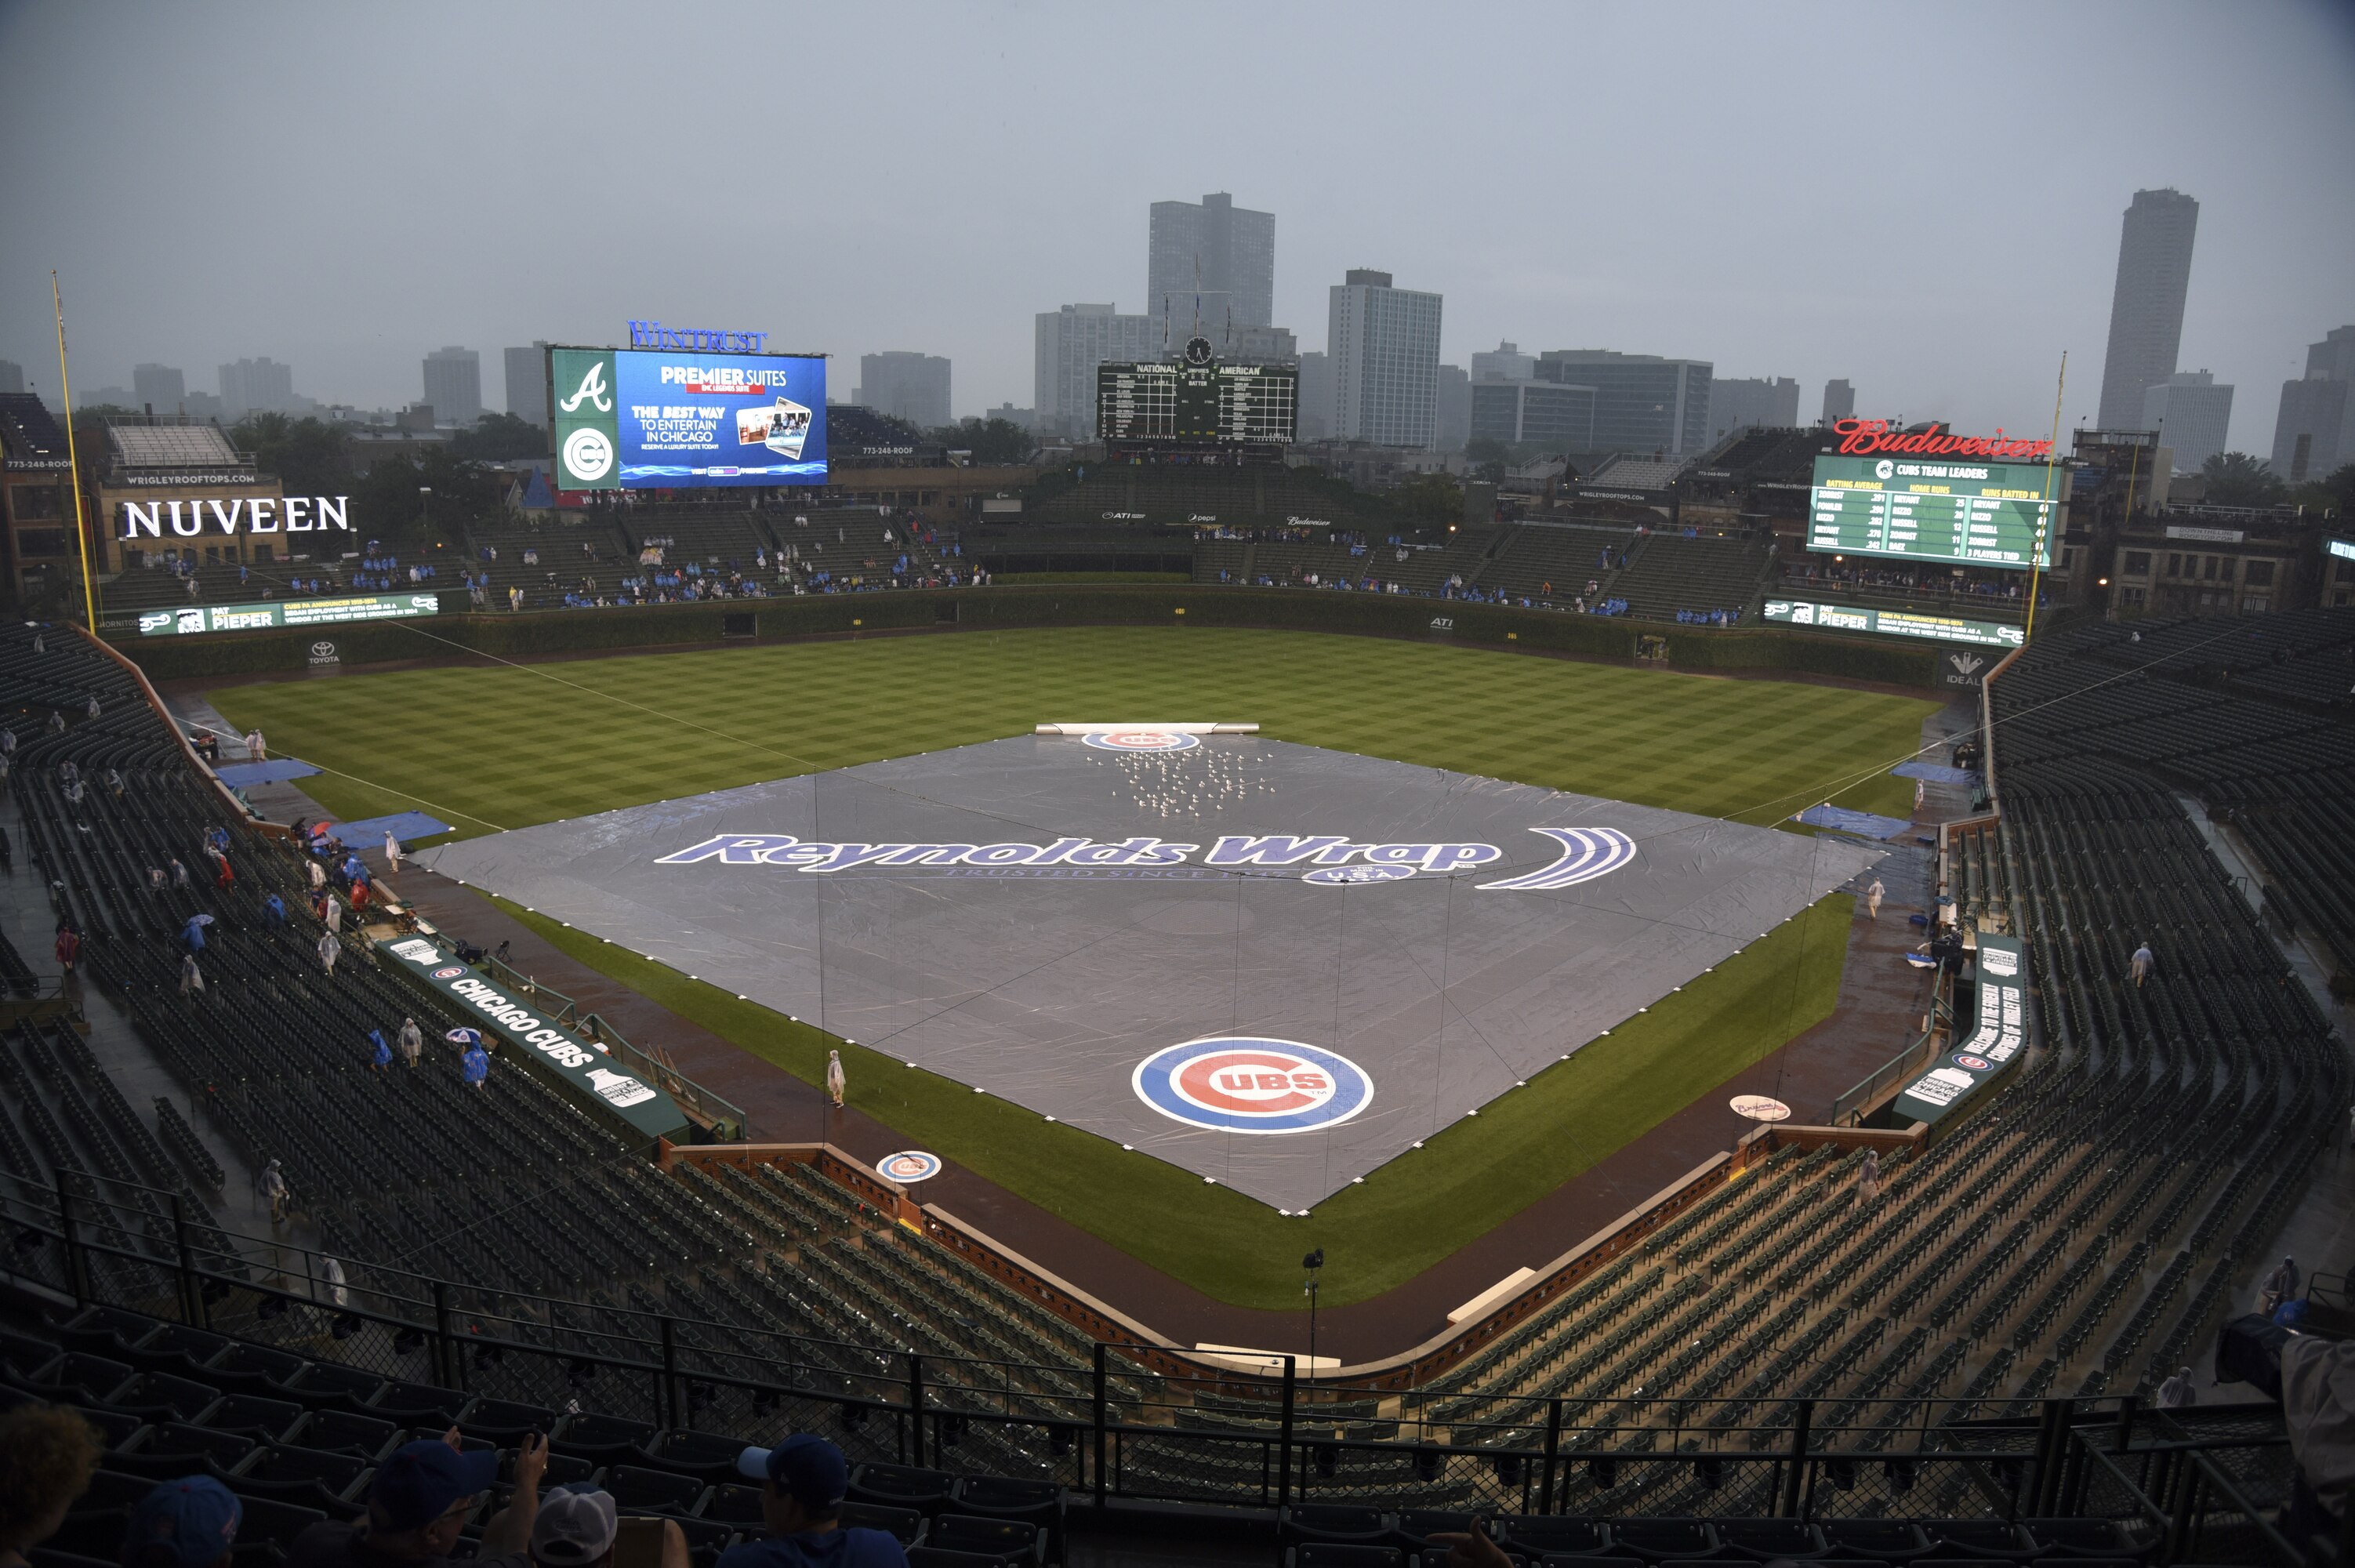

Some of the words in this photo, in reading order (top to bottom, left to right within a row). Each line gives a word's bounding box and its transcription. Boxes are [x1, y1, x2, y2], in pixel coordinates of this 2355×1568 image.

[627, 320, 767, 352] WINTRUST
[1137, 365, 1178, 373] NATIONAL
[1219, 367, 1260, 376] AMERICAN
[661, 366, 744, 386] PREMIER
[746, 369, 787, 387] SUITES
[631, 406, 659, 419] THE
[662, 406, 697, 419] BEST
[698, 407, 726, 419] WAY
[640, 419, 656, 430] TO
[659, 419, 717, 430] ENTERTAIN
[647, 431, 659, 442] IN
[660, 431, 713, 442] CHICAGO
[1834, 419, 2054, 458] Budweiser
[1897, 464, 1920, 477] CUBS
[1921, 466, 1947, 477] TEAM
[1949, 466, 1988, 480] LEADERS
[128, 475, 255, 485] WRIGLEYROOFTOPS.COM
[1826, 479, 1853, 488] BATTING
[1854, 481, 1883, 491] AVERAGE
[1909, 485, 1929, 493] HOME
[1931, 485, 1950, 495] RUNS
[1981, 488, 2001, 498] RUNS
[2001, 489, 2029, 499] BATTED
[2030, 491, 2039, 499] IN
[1579, 492, 1645, 501] WRIGLEYROOFTOPS.COM
[1894, 495, 1920, 504] BRYANT
[1956, 499, 1965, 507] 25
[1817, 503, 1842, 511] FOWLER
[1972, 499, 2001, 510] BRYANT
[124, 496, 349, 538] NUVEEN
[1286, 516, 1330, 526] Budweiser
[1815, 525, 1840, 535] BRYANT
[1891, 518, 1918, 528] RUSSELL
[1953, 522, 1962, 532] 12
[1969, 524, 1998, 535] RUSSELL
[1813, 536, 1838, 546] RUSSELL
[1952, 535, 1961, 544] 11
[1888, 543, 1906, 551] BAEZ
[1954, 547, 1959, 556] 9
[1967, 548, 1972, 557] 3
[1973, 550, 2002, 560] PLAYERS
[2003, 551, 2019, 561] TIED
[212, 607, 230, 616] PAT
[307, 607, 349, 615] EMPLOYMENT
[100, 619, 139, 628] HORNITOS
[212, 613, 274, 630] PIEPER
[1430, 618, 1453, 627] ATI
[1818, 613, 1867, 630] PIEPER
[1902, 615, 1937, 623] ANNOUNCER
[1898, 620, 1935, 630] EMPLOYMENT
[1950, 633, 1979, 641] GROUNDS
[308, 656, 340, 665] TOYOTA
[1947, 674, 1981, 686] IDEAL
[654, 834, 1199, 871] Reynolds
[1204, 835, 1502, 872] Wrap
[945, 869, 1094, 878] TRUSTED
[1101, 870, 1205, 880] SINCE
[2002, 986, 2020, 1003] FIELD
[1981, 1007, 1999, 1019] THE
[2002, 1000, 2021, 1026] WRIGLEY
[450, 978, 541, 1032] CHICAGO
[524, 1029, 594, 1068] CUBS
[1981, 1018, 1999, 1027] TO
[2002, 1024, 2022, 1036] OF
[1963, 1026, 1999, 1054] WELCOME
[1987, 1033, 2021, 1062] CONFINES
[599, 1082, 627, 1094] weber
[1917, 1080, 1959, 1097] CHICAGO
[1925, 1077, 1954, 1089] weber
